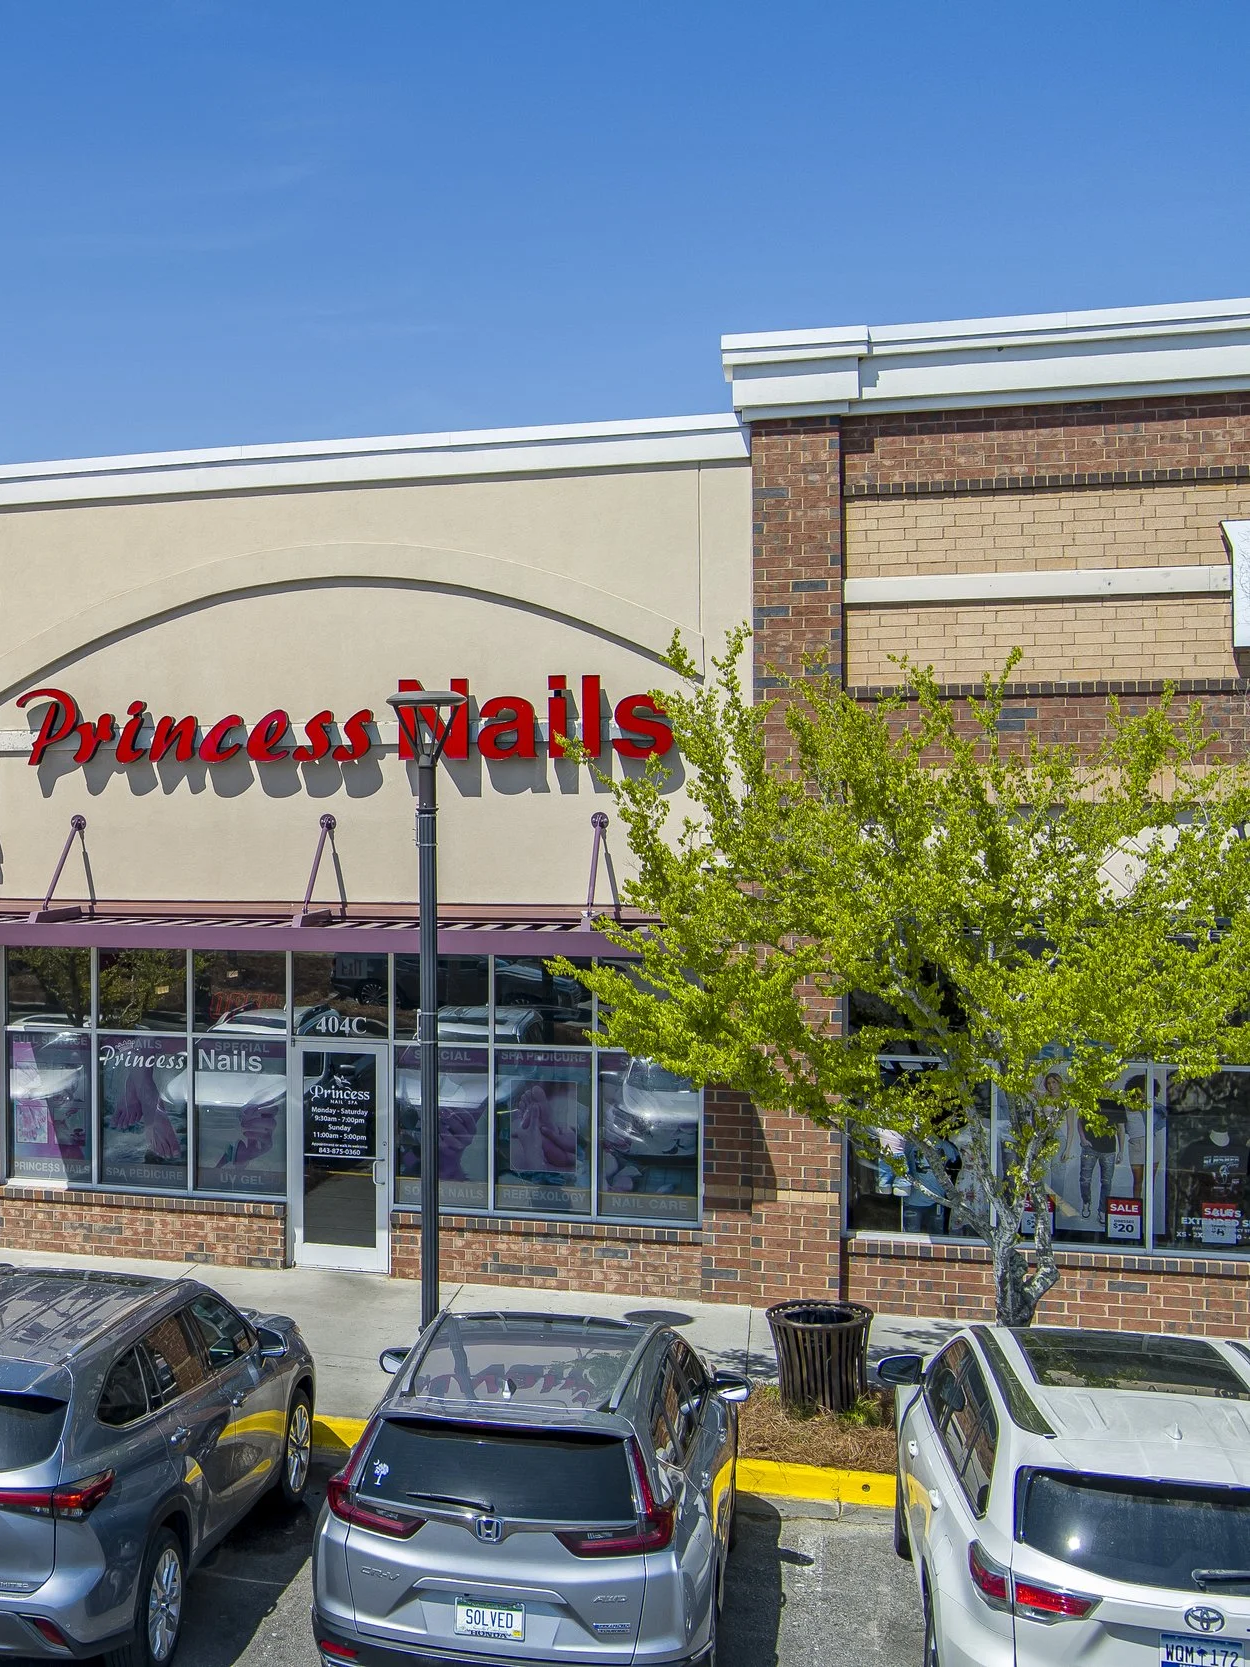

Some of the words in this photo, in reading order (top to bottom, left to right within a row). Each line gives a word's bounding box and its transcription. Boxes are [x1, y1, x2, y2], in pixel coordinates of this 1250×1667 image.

[16, 687, 375, 766] Princess
[397, 674, 676, 761] Nails
[315, 1015, 367, 1035] 404C
[12, 1034, 38, 1044] FULL
[213, 1041, 271, 1053] SPECIAL
[99, 1044, 187, 1070] Princess
[198, 1048, 264, 1073] Nails
[414, 1048, 472, 1062] SCIAL
[500, 1051, 524, 1061] SPA
[526, 1051, 587, 1063] PEDICURE
[309, 1084, 371, 1102] Princess
[311, 1106, 337, 1115] Monday
[340, 1107, 369, 1117] Saturday
[341, 1116, 365, 1125] 7:00pm
[328, 1123, 352, 1133] Sunday
[313, 1131, 339, 1139] 11:00am
[343, 1133, 367, 1142] 5:00pm
[14, 1160, 60, 1173] PRINCESS
[62, 1163, 90, 1174] NAILS
[105, 1166, 126, 1177] SPA
[129, 1168, 183, 1181] PEDICURE
[219, 1173, 237, 1183] UV
[240, 1174, 264, 1185] GEL
[448, 1188, 484, 1200] NAILS
[503, 1188, 586, 1203] REFLEXOLOGY
[611, 1196, 644, 1209] NAIL
[649, 1199, 688, 1211] CARE
[1110, 1203, 1139, 1213] SALE
[1113, 1223, 1134, 1233] $20
[360, 1564, 400, 1582] CR-V
[592, 1594, 628, 1604] AWD
[465, 1608, 514, 1629] SOLVED
[470, 1629, 508, 1639] HONDA
[1165, 1643, 1195, 1664] WQM
[1210, 1648, 1240, 1667] 172
